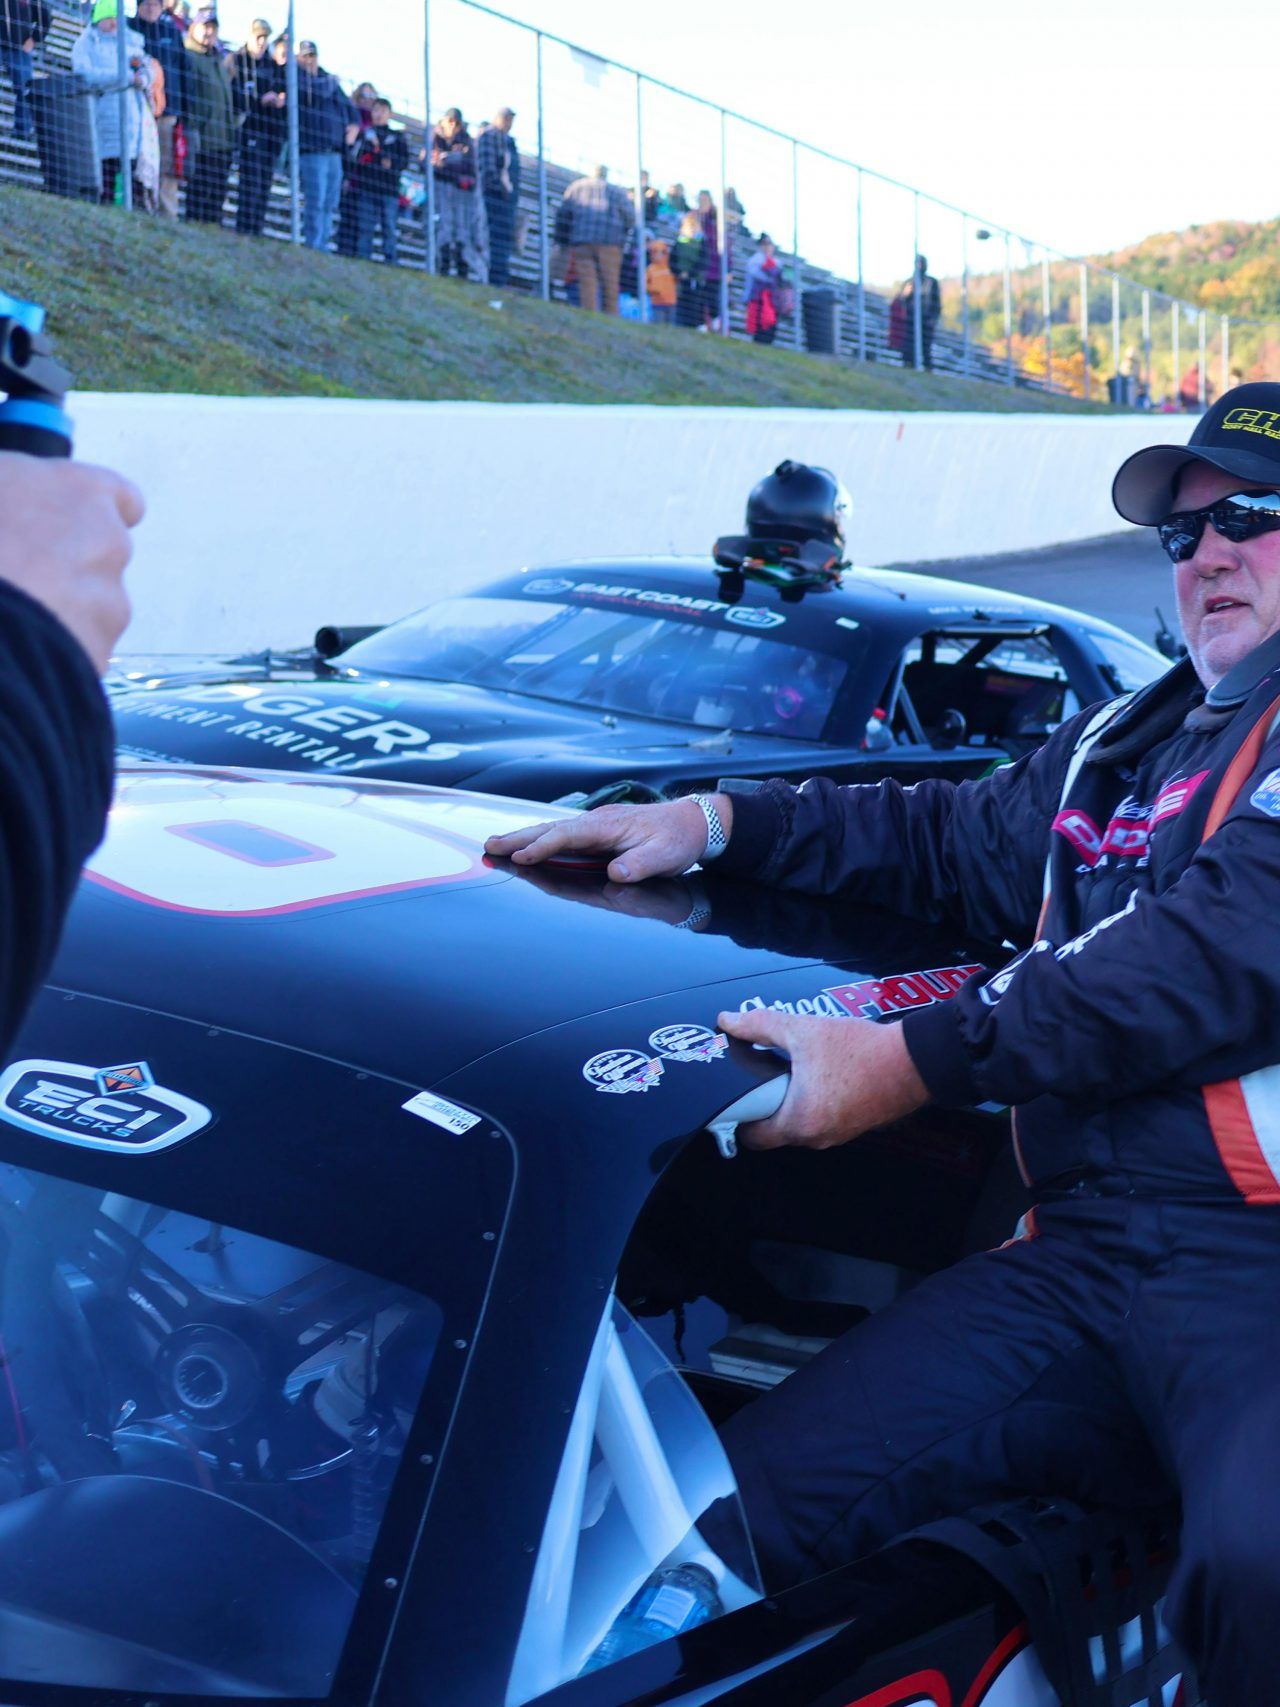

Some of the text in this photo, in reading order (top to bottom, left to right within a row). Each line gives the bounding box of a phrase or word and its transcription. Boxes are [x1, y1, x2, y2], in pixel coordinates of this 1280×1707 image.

[572, 582, 641, 598] EAST
[636, 590, 730, 612] COAST
[225, 720, 368, 771] RENTALS
[18, 1099, 137, 1138] TRUCKS
